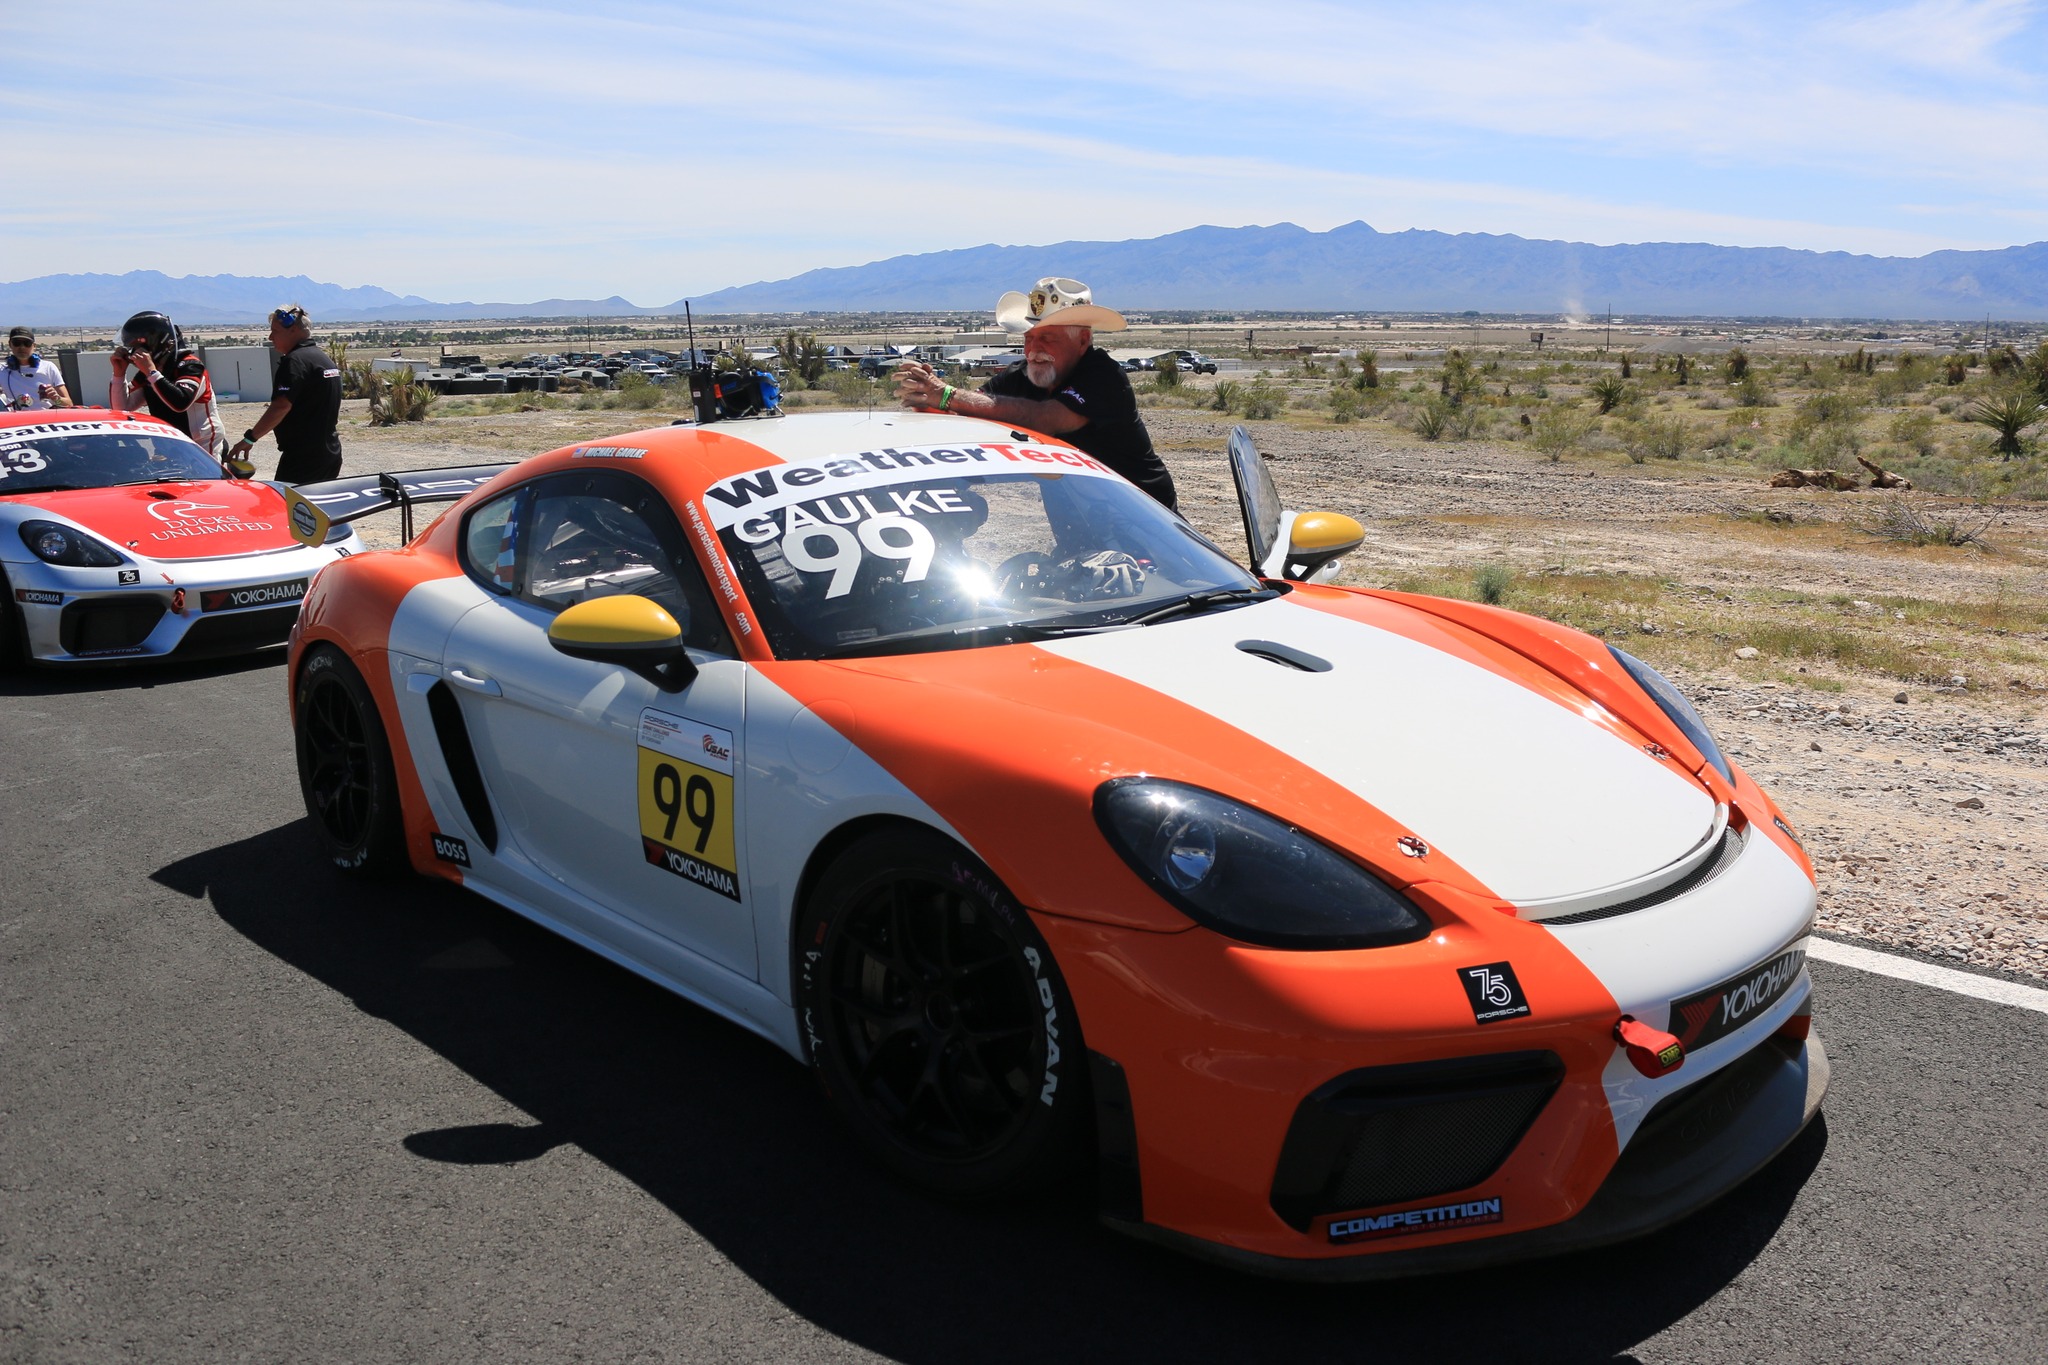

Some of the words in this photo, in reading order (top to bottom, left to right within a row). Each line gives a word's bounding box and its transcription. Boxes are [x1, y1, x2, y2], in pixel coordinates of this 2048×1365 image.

[615, 448, 648, 458] GAULKE
[705, 444, 1113, 509] WeatherTech
[150, 522, 273, 541] UNLIMITED
[165, 516, 240, 529] DUCKS
[733, 489, 972, 544] GAULKE
[685, 499, 739, 603] www.porschemotorsport
[735, 611, 752, 636] .com
[781, 516, 936, 600] 99
[231, 583, 304, 605] YOKOHAMA
[706, 744, 730, 758] USAC
[653, 763, 715, 854] 99
[435, 839, 467, 862] BOSS
[665, 850, 736, 896] YOKOHAMA
[1469, 968, 1512, 1006] 75
[1023, 946, 1060, 1107] ADVAN
[1477, 1006, 1529, 1020] PORSCHE
[1660, 1047, 1681, 1064] OMP
[1330, 1199, 1500, 1236] COMPETITION
